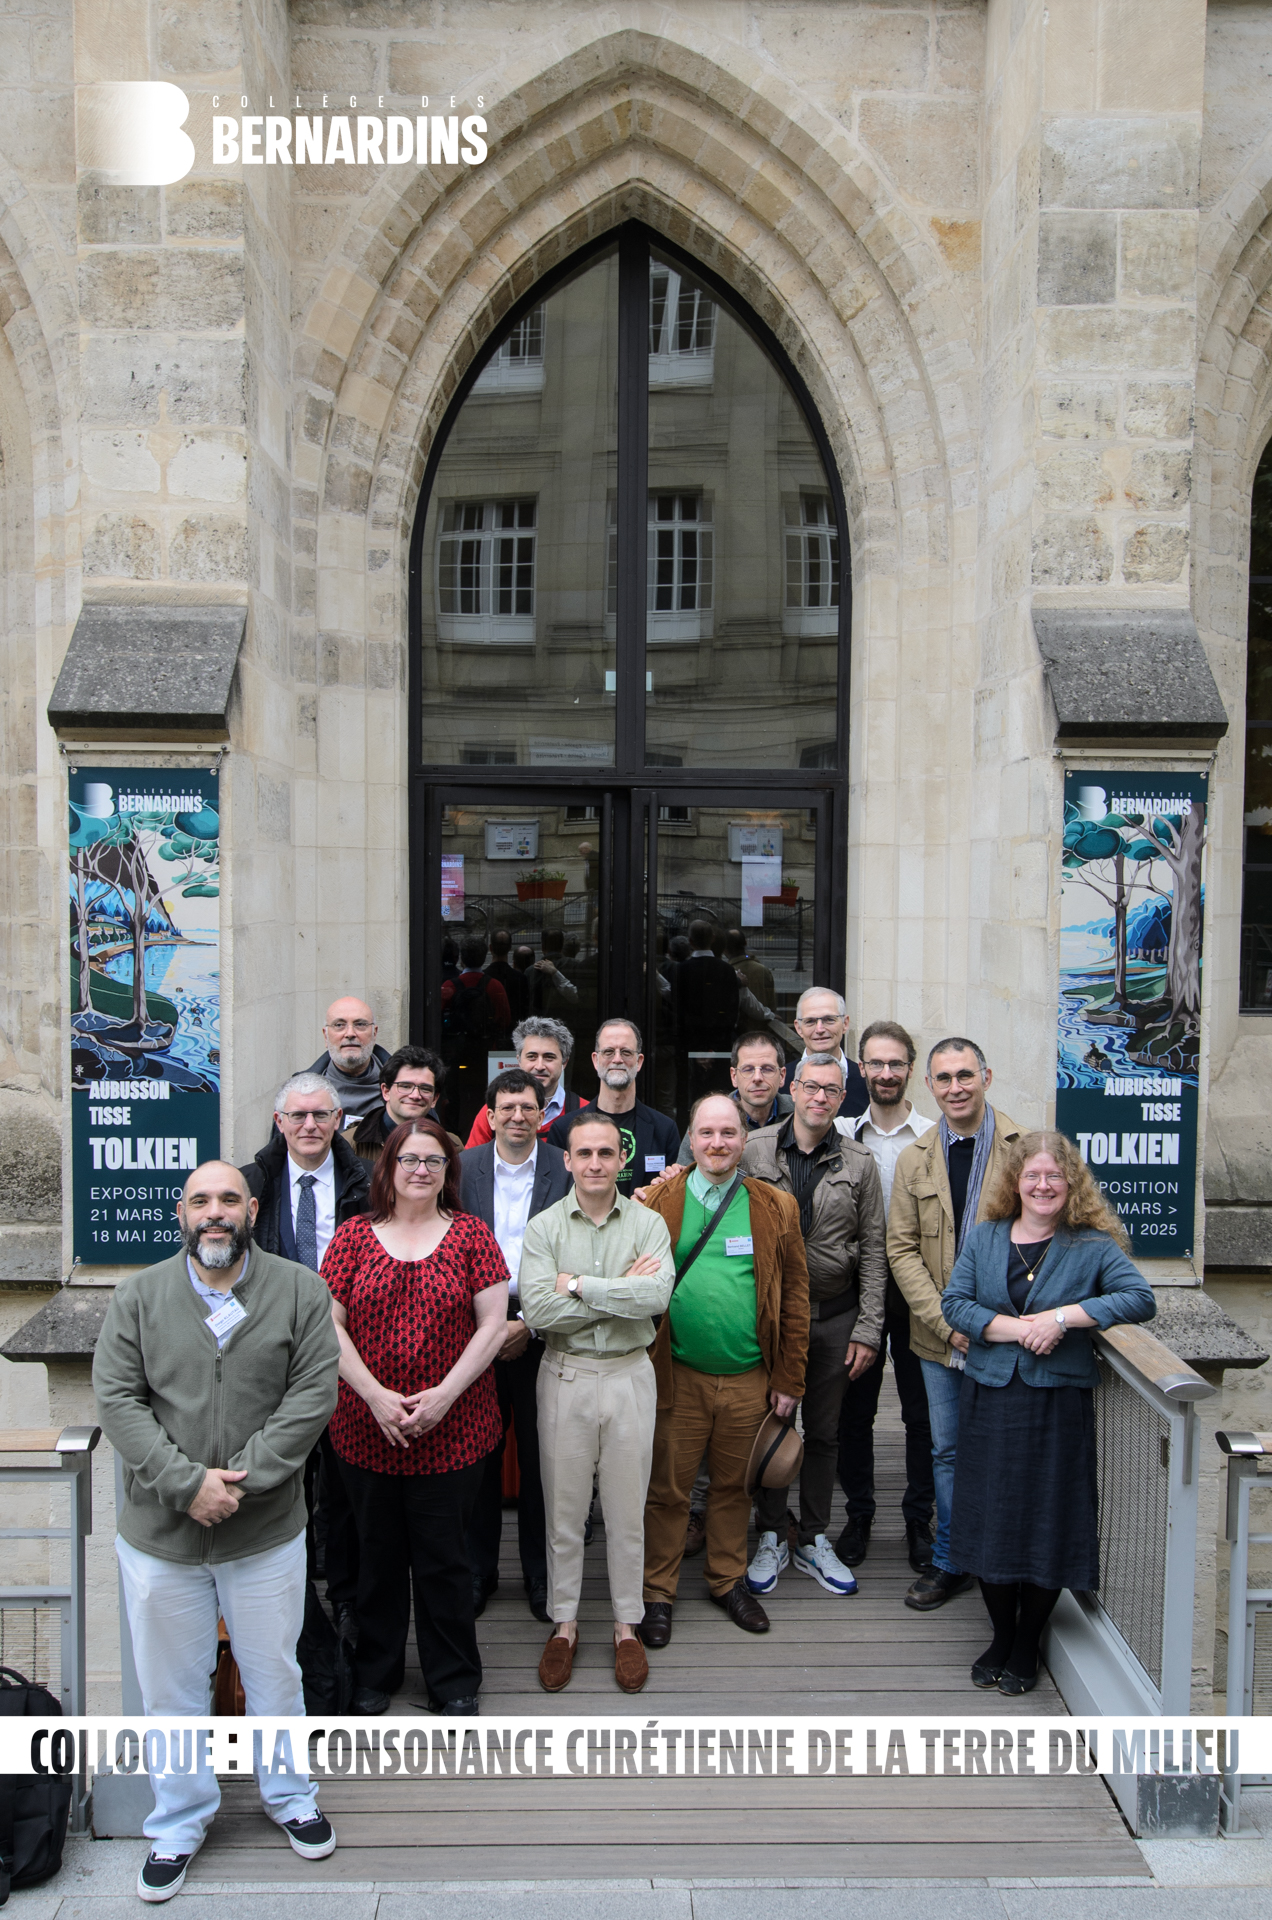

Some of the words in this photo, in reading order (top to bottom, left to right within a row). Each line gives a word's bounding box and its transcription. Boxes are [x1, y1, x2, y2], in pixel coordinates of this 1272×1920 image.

[118, 795, 203, 813] BERNARDINS
[1111, 798, 1192, 815] BERNARDINS
[89, 1081, 170, 1100] AUBUSSON
[1104, 1077, 1181, 1096] AUBUSSON
[89, 1106, 131, 1125] TISSE
[1141, 1103, 1181, 1121] TISSE
[89, 1137, 197, 1170] TOLKIEN
[1076, 1132, 1180, 1165] TOLKIEN
[90, 1187, 183, 1200] EXPOSITIO
[1093, 1181, 1178, 1194] POSITION
[91, 1209, 109, 1221] 21
[116, 1208, 163, 1221] MARS
[1116, 1202, 1162, 1215] MARS
[1168, 1205, 1178, 1215] >
[92, 1230, 110, 1242] 18
[116, 1230, 146, 1242] MAI
[153, 1230, 182, 1242] 202
[1140, 1223, 1178, 1236] 2025
